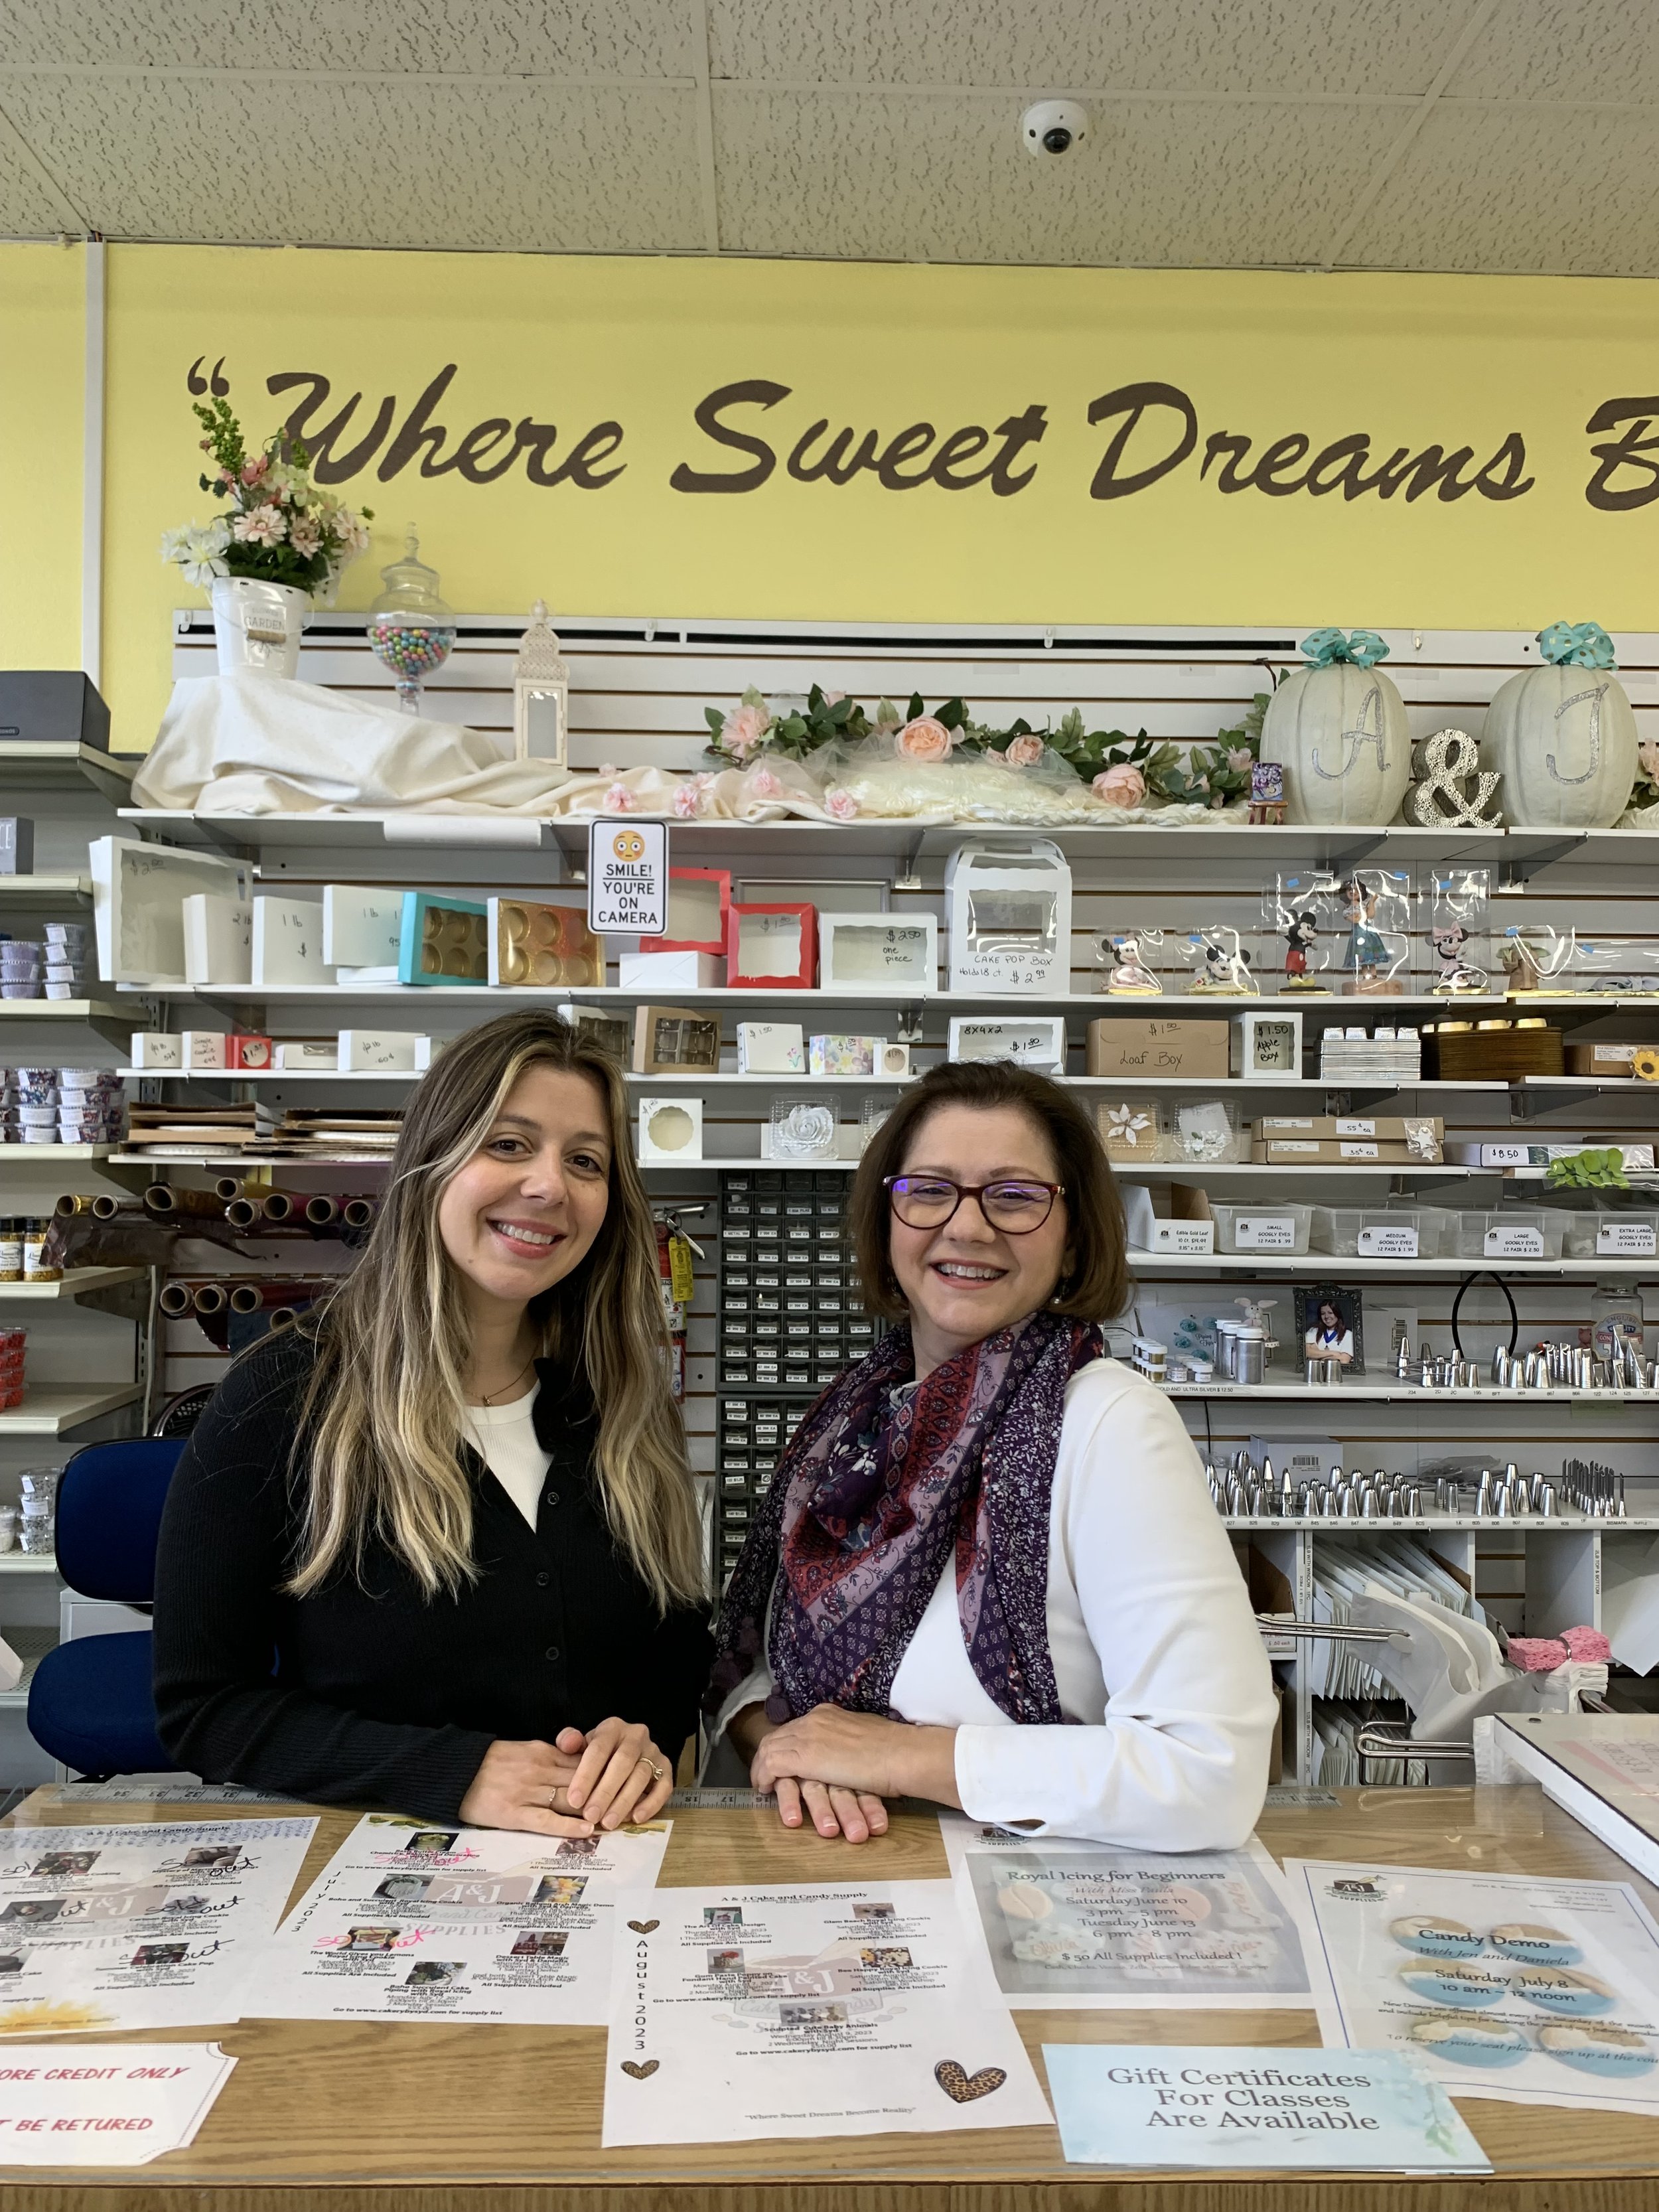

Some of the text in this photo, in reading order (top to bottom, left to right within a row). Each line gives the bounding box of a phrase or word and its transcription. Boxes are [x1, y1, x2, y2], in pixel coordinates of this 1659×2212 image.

[670, 380, 1048, 496] Sweet
[1088, 382, 1535, 502] Dreams
[244, 617, 285, 630] GARDEN
[1312, 687, 1391, 782] A
[606, 864, 652, 877] SMILE!
[603, 882, 654, 895] YOU'RE
[619, 897, 638, 909] ON
[599, 911, 657, 924] CAMERA
[883, 946, 899, 954] one
[885, 954, 913, 966] piece
[975, 956, 999, 964] CAKE
[1005, 955, 1025, 964] POP
[1257, 1039, 1280, 1051] Apple
[1120, 1050, 1183, 1071] Loaf Box
[1498, 1149, 1519, 1159] 8.50
[1007, 1871, 1226, 1883] Royal Icing for Beginners
[1066, 1897, 1132, 1907] Saturday
[1133, 1897, 1168, 1907] June
[1153, 1909, 1179, 1917] pm
[1078, 1919, 1139, 1928] Tuesday
[1140, 1919, 1175, 1928] June
[1108, 1931, 1134, 1940] pm
[1167, 1931, 1192, 1940] pm
[1419, 1929, 1550, 1949] Candy Demo
[1116, 1953, 1173, 1962] Supplies
[1418, 1947, 1453, 1956] With
[1455, 1949, 1479, 1958] Jen
[1516, 1956, 1569, 1966] Daniela
[1435, 1969, 1568, 1990] Saturday July 8
[1531, 1992, 1577, 2002] noon
[634, 2005, 646, 2050] 2023
[1406, 2035, 1447, 2044] reserve
[1449, 2039, 1478, 2049] your
[1480, 2042, 1504, 2051] seat
[1506, 2045, 1545, 2055] please
[1549, 2048, 1574, 2058] sign
[1578, 2051, 1595, 2060] up
[1614, 2053, 1634, 2061] the
[44, 2068, 122, 2081] CREDIT
[127, 2067, 190, 2079] ONLY
[1108, 2067, 1372, 2088] Gift Certificates
[1154, 2089, 1350, 2108] For Classes
[845, 2108, 881, 2116] Become
[15, 2118, 154, 2131] BE RETURED
[1145, 2110, 1380, 2130] Are Available
